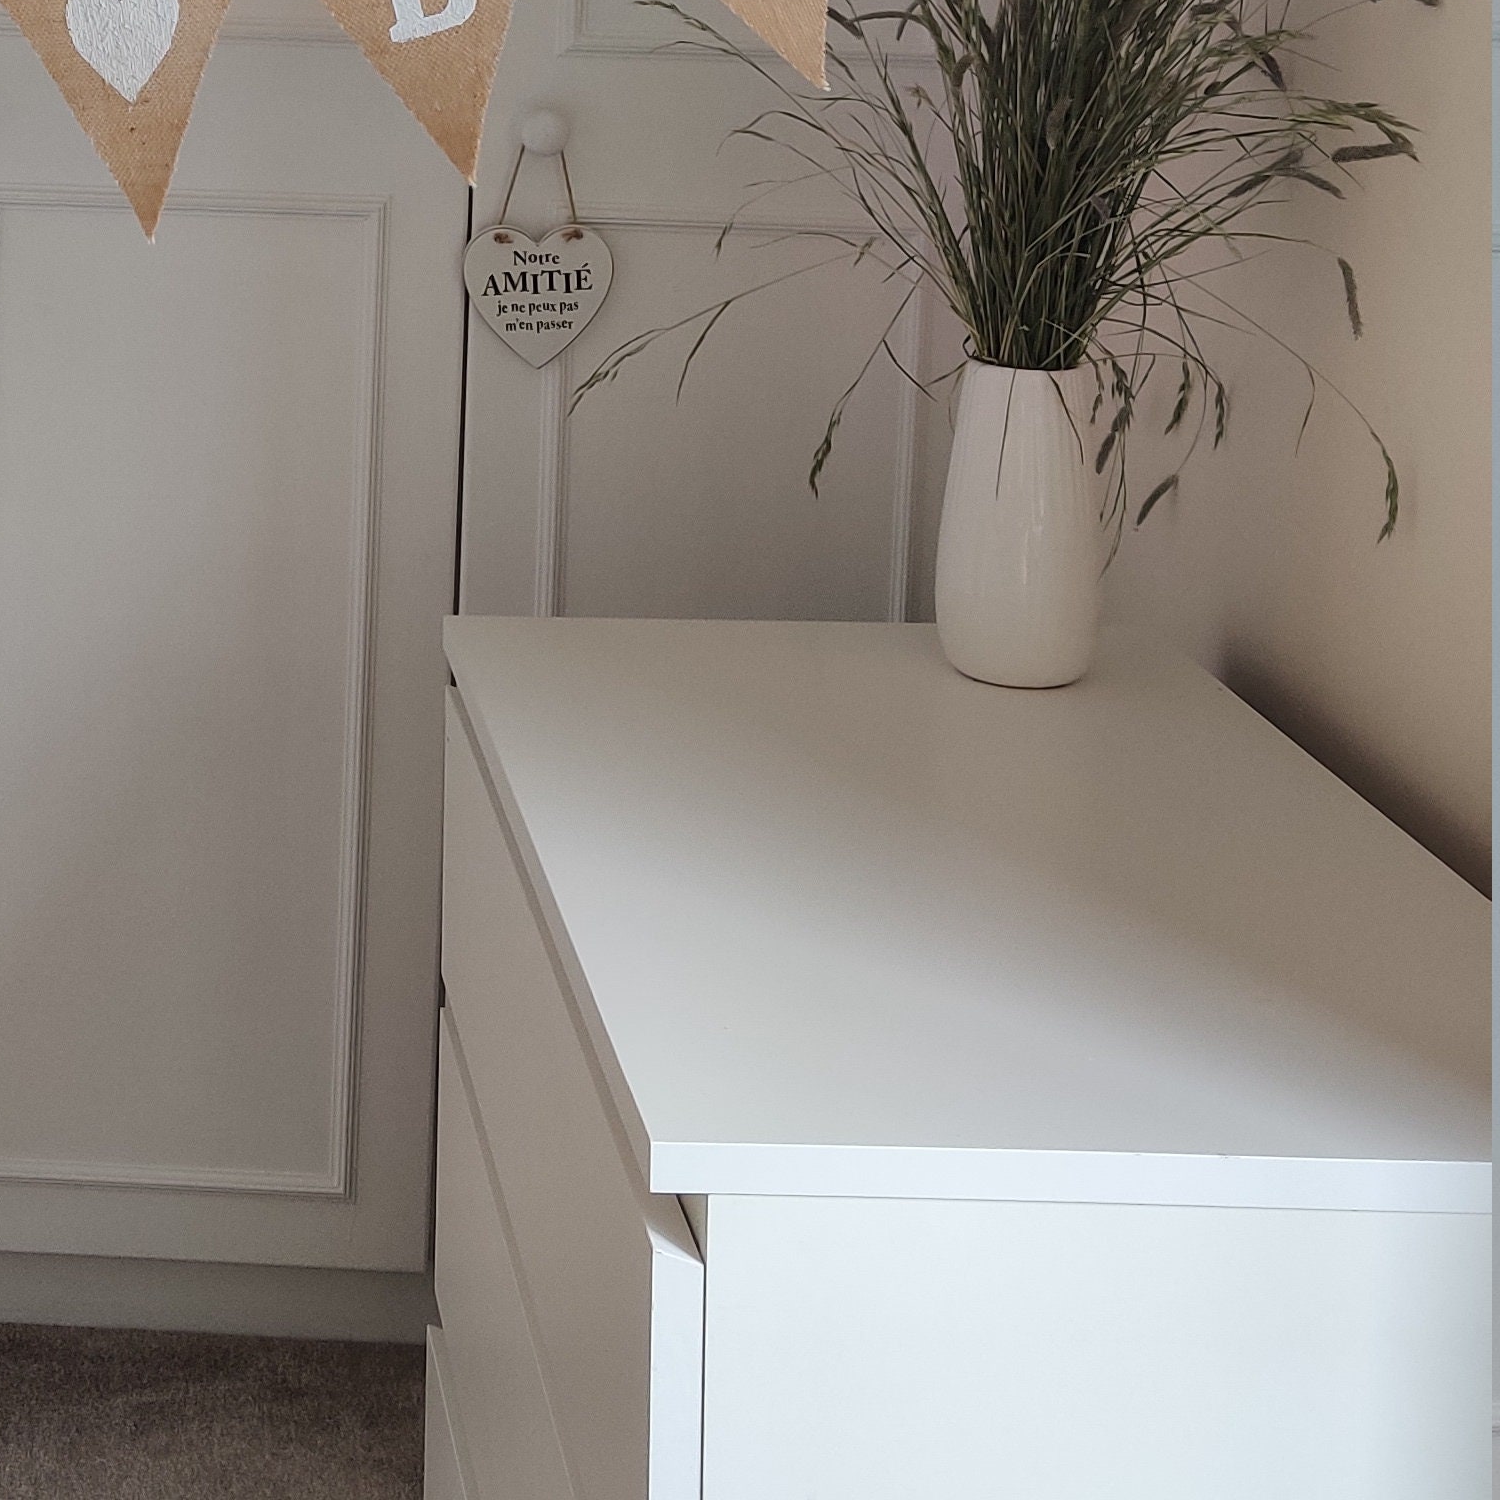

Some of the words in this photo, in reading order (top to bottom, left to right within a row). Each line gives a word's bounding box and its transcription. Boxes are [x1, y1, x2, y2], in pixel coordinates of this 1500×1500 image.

[513, 250, 561, 266] Notre
[481, 263, 593, 297] AMITIÉ
[496, 301, 508, 317] je
[511, 303, 526, 313] ne
[528, 303, 557, 316] peux
[559, 301, 579, 314] pas
[505, 318, 534, 332] m'en
[536, 319, 574, 334] passer
